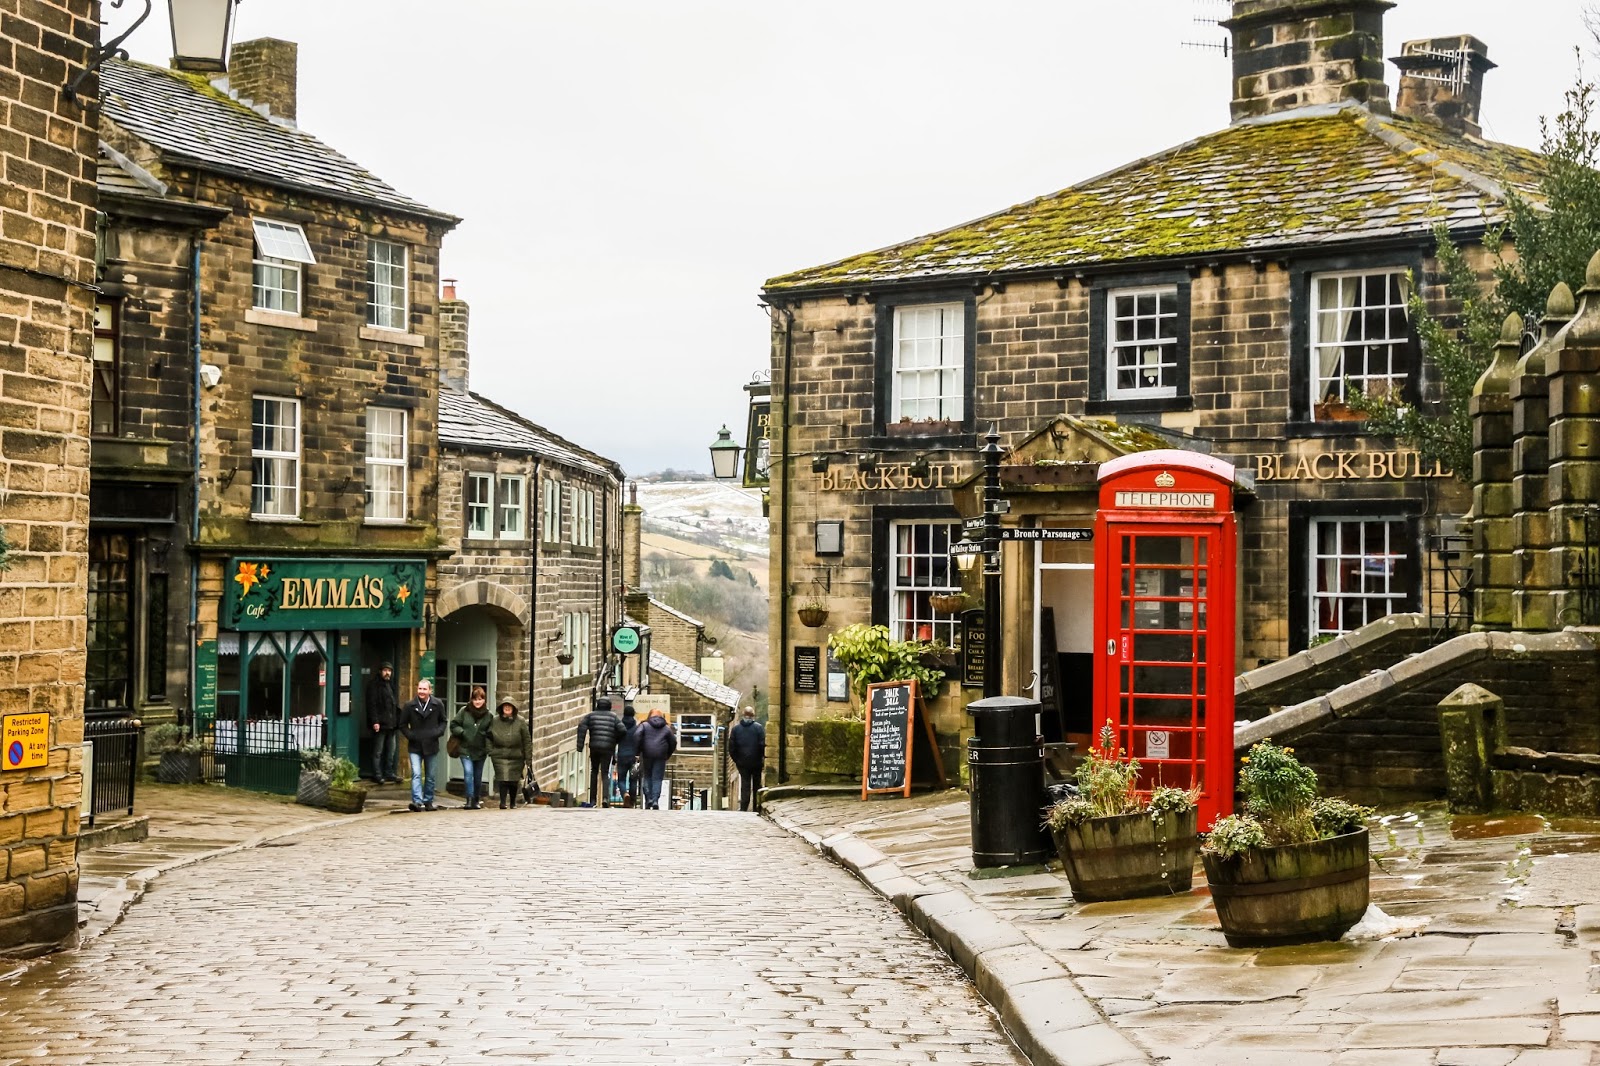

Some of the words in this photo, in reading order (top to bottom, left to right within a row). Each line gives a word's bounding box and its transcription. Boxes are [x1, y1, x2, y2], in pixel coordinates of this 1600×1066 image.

[1255, 452, 1360, 481] BLACK
[1366, 450, 1454, 479] BULL
[819, 466, 898, 491] BLACK
[1120, 493, 1211, 506] TELEPHONE
[1014, 530, 1039, 538] Bronte
[1042, 530, 1080, 540] Parsonage
[279, 575, 384, 609] EMMA'S
[246, 604, 264, 618] Cafe
[968, 631, 985, 640] FOO
[12, 717, 41, 726] Restricted
[8, 728, 30, 736] Parking
